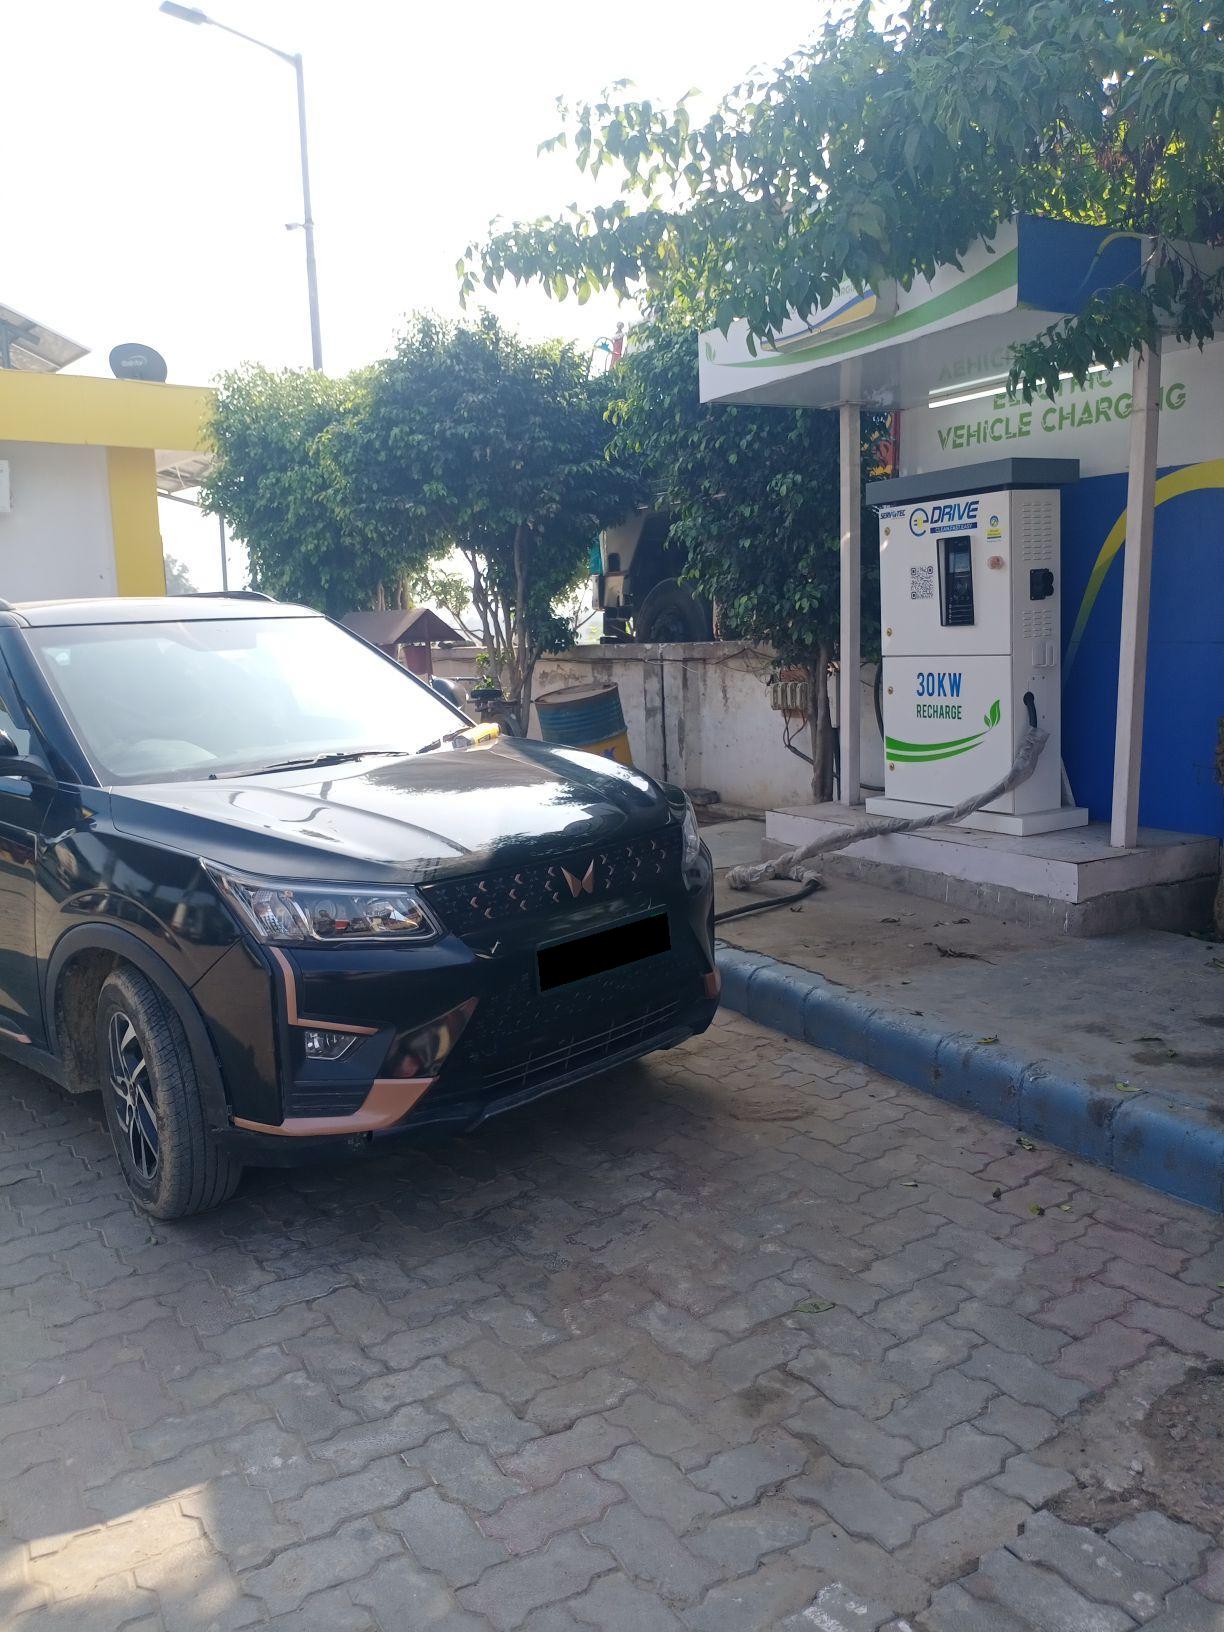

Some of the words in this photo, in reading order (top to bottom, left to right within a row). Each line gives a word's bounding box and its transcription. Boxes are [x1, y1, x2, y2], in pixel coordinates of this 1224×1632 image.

[1040, 383, 1186, 433] CHARGG
[916, 672, 962, 698] 30KW
[916, 703, 963, 720] RECHARGE
